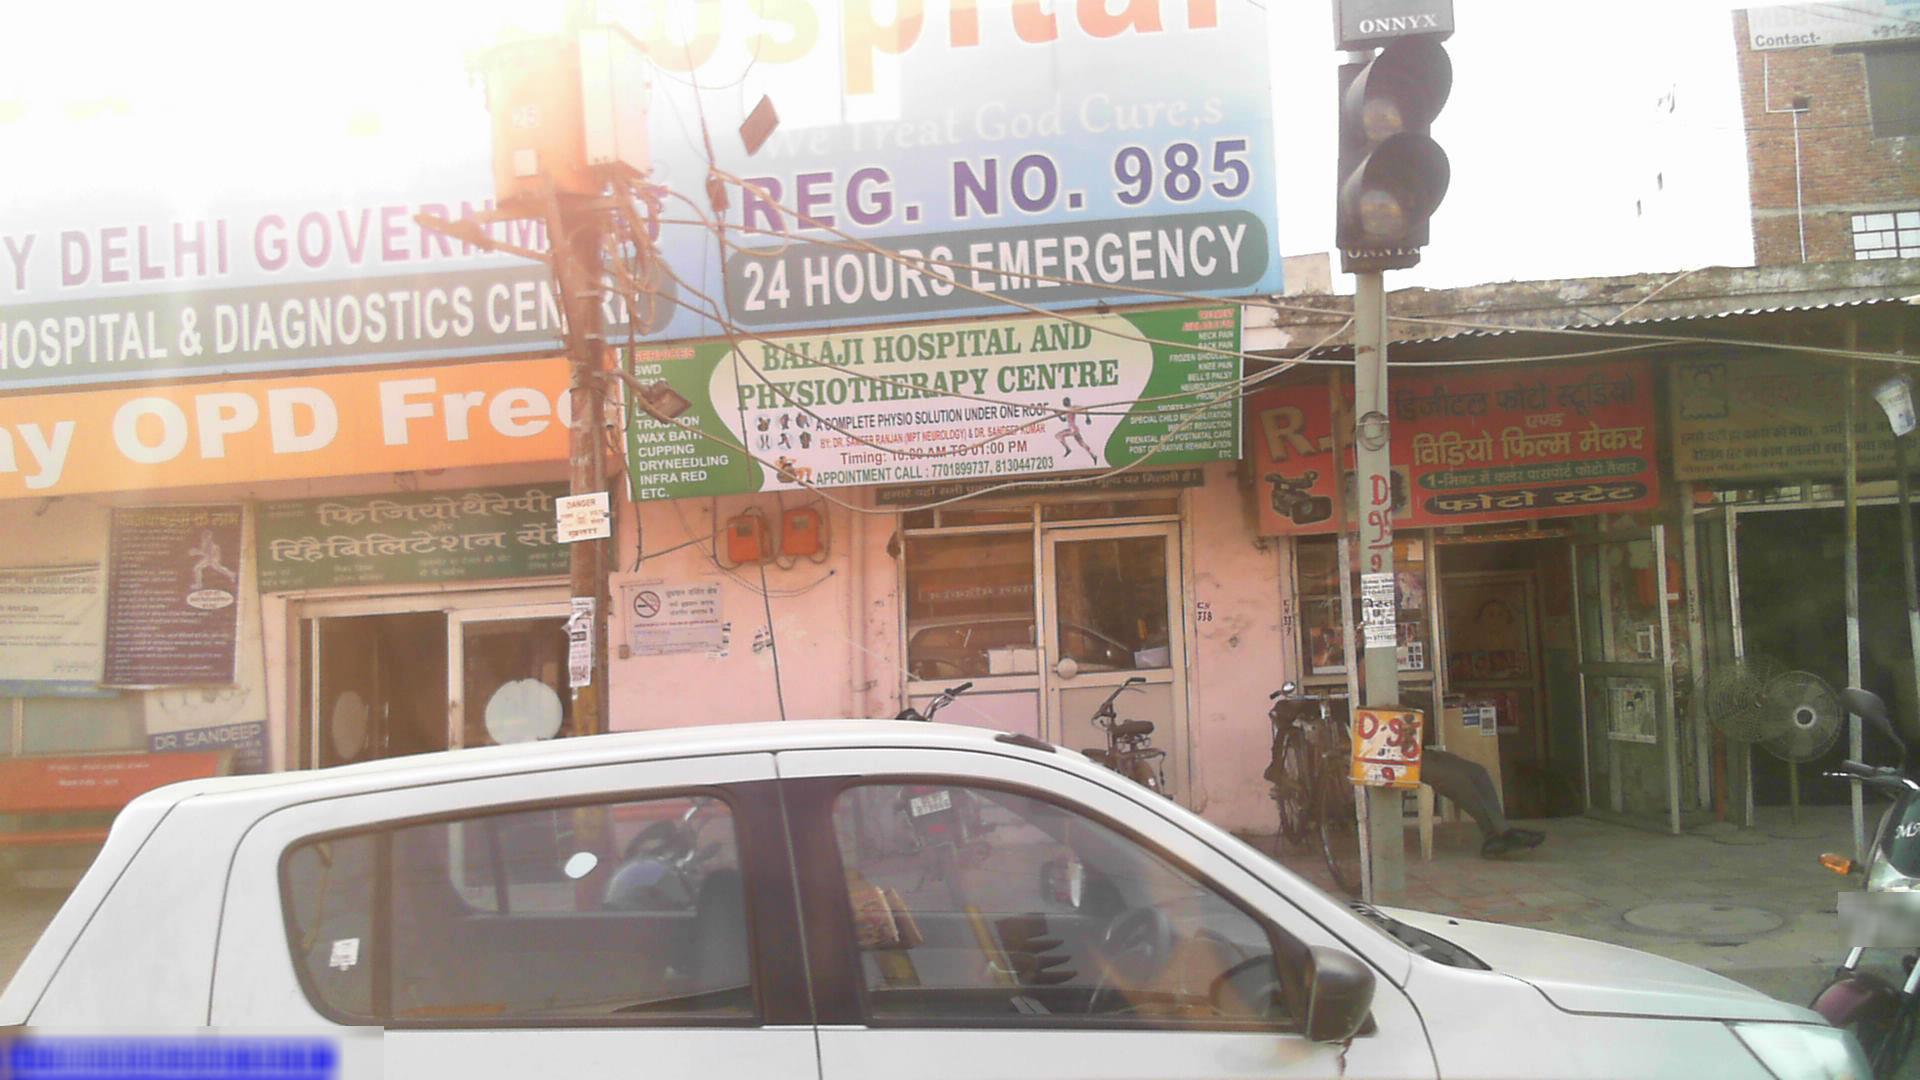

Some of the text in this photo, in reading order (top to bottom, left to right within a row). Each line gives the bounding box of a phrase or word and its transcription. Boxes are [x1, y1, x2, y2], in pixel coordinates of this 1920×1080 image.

[1358, 13, 1439, 33] ONNYX
[1754, 31, 1821, 47] Contact-
[840, 111, 966, 154] Treat
[975, 100, 1065, 140] God
[740, 138, 1251, 235] REG. NO. 985
[60, 218, 229, 288] DELHI
[743, 223, 1249, 312] 24 HOURS EMERGENCY
[178, 308, 204, 357] &
[215, 286, 474, 355] DIAGNOSTICS
[486, 275, 642, 334] CENRE
[761, 321, 1093, 372] BALAJI HOSPITAL AND
[634, 364, 662, 376] SWD
[737, 359, 1120, 411] PHYSIOTHERAPY CENTRE
[112, 385, 339, 465] OPD
[635, 416, 700, 430] TRACION
[826, 413, 874, 431] COMPLETE
[877, 411, 913, 428] PHYSIO
[914, 407, 963, 426] SOLUTION
[964, 405, 998, 422] UNDER
[999, 405, 1021, 420] ONE
[1022, 402, 1050, 417] ROOF
[636, 432, 666, 444] WAX
[638, 443, 695, 458] CUPPING
[1412, 420, 1646, 466] विडियो फिल्म मेकर
[639, 455, 730, 472] DRYNEEDLING
[840, 451, 887, 467] Timing:
[927, 446, 947, 459] AM
[951, 444, 968, 457] TO
[1008, 439, 1028, 454] PM
[640, 470, 708, 486] INFRA RED
[815, 466, 893, 486] APPOINTMENT
[895, 464, 923, 481] CALL
[995, 455, 1054, 473] 8130447203
[641, 487, 671, 500] ETC.
[1437, 485, 1637, 513] फोटो स्टेट
[516, 522, 557, 546] सें
[183, 723, 262, 748] SANDEEP
